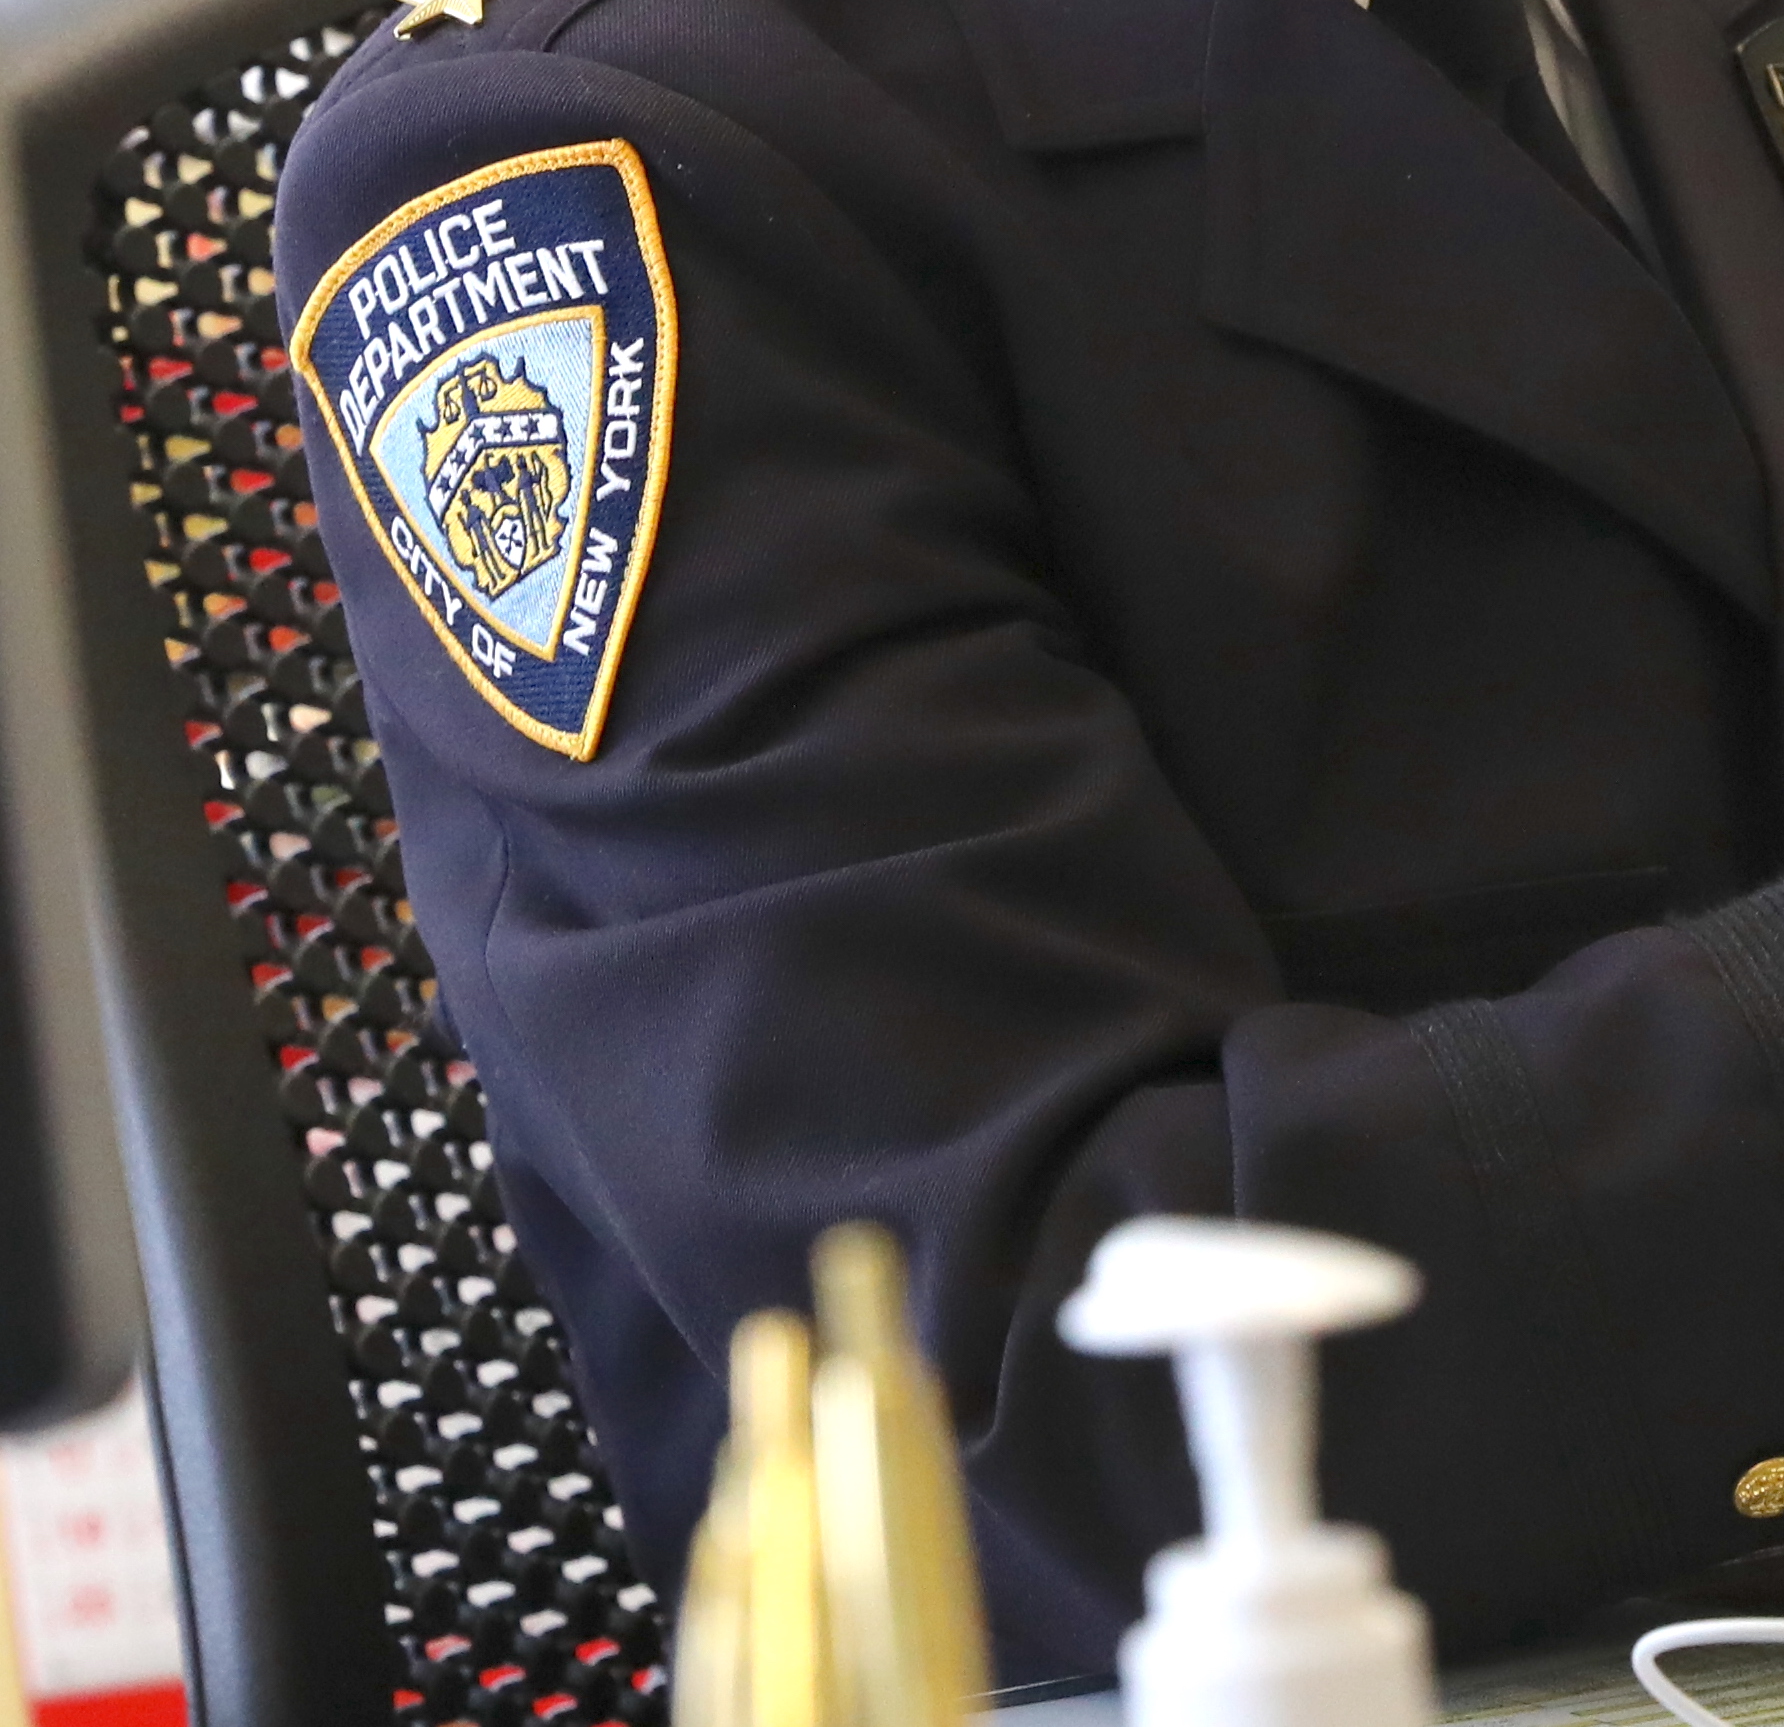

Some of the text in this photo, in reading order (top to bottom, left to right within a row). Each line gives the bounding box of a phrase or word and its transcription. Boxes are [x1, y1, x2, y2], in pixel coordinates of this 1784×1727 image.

[338, 239, 608, 457] DEPARTMENT
[348, 200, 516, 339] POLICE
[563, 338, 645, 656] NEW YORK
[390, 516, 517, 678] CITY OF
